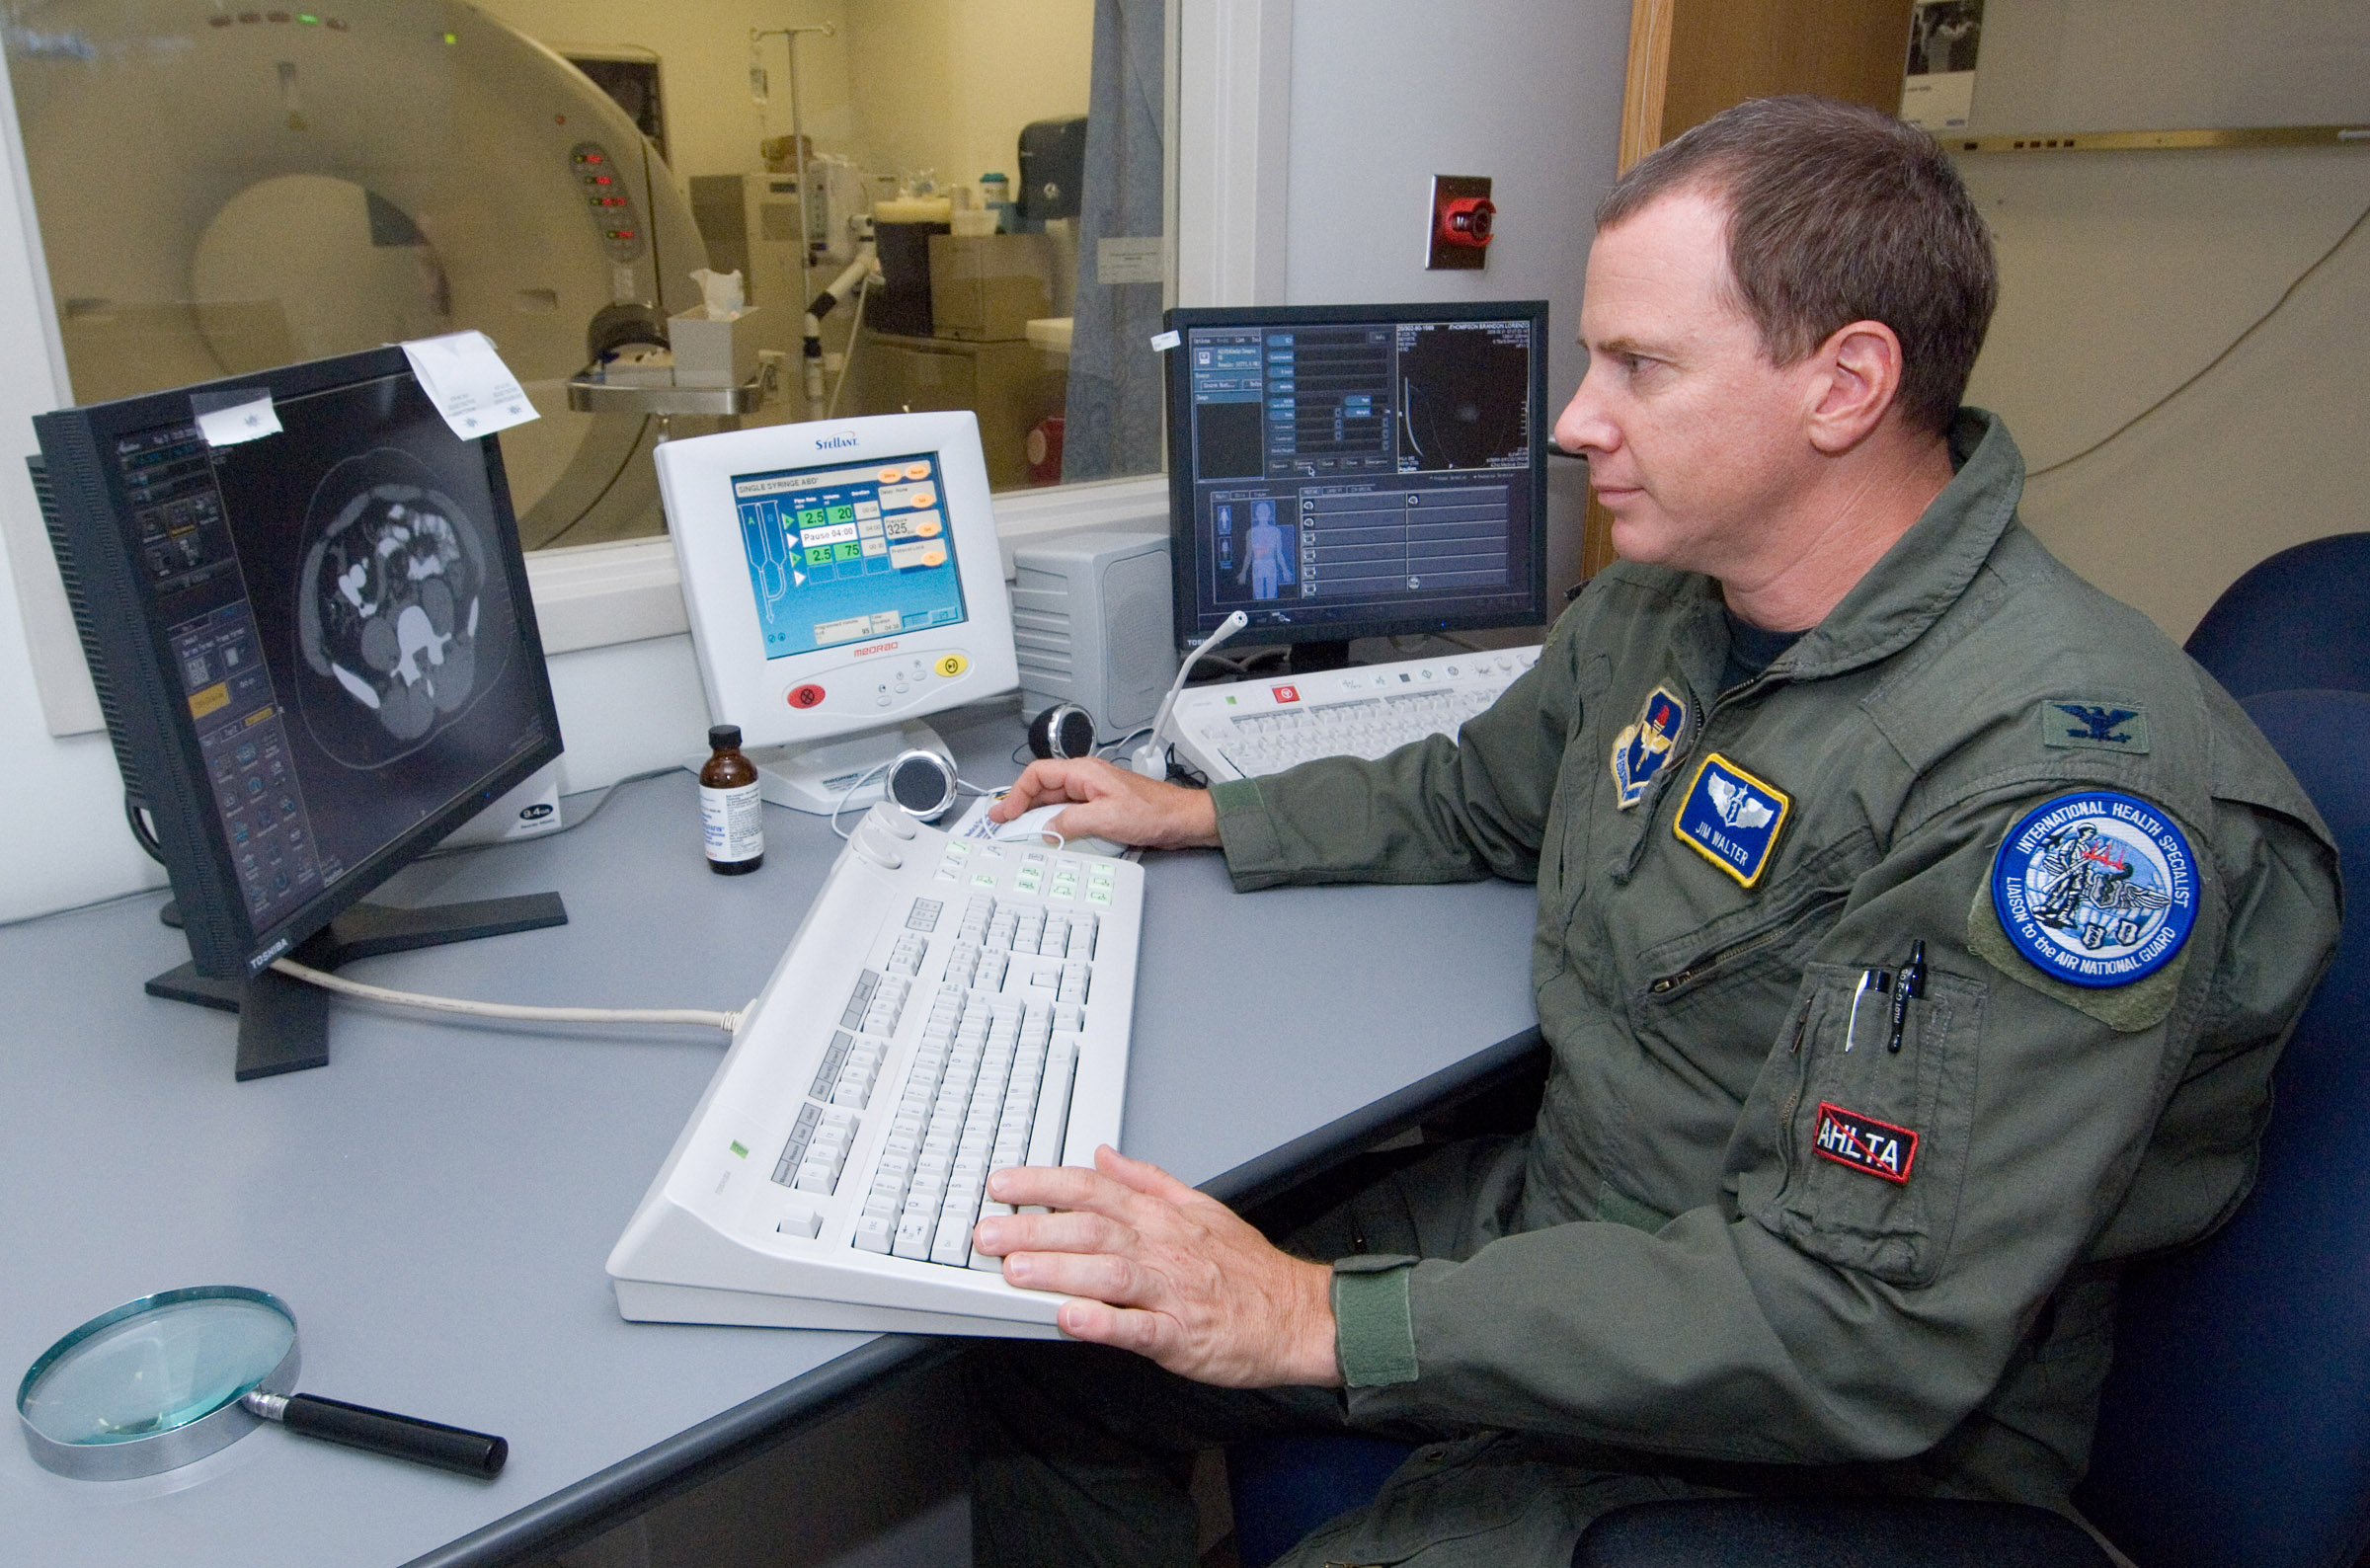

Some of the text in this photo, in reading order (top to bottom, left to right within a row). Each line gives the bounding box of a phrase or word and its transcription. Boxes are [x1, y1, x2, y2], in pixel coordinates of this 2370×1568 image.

[739, 484, 766, 494] SINGLE
[767, 480, 799, 490] SYRINGE
[749, 516, 754, 525] A
[806, 511, 824, 524] 2.5
[837, 508, 852, 519] 20
[804, 527, 853, 541] Pause 04:00
[887, 523, 908, 535] 325
[813, 549, 831, 562] 2.5
[845, 544, 859, 557] 75
[1695, 821, 1749, 867] JIM WALTER
[2016, 801, 2190, 908] INTERNATIONAL HEALTH SPECIALIST
[2006, 876, 2176, 976] LIAISON to the AIR NATIONAL GUARD
[250, 938, 288, 969] TOSHIBA
[1817, 1117, 1900, 1173] AHLTA
